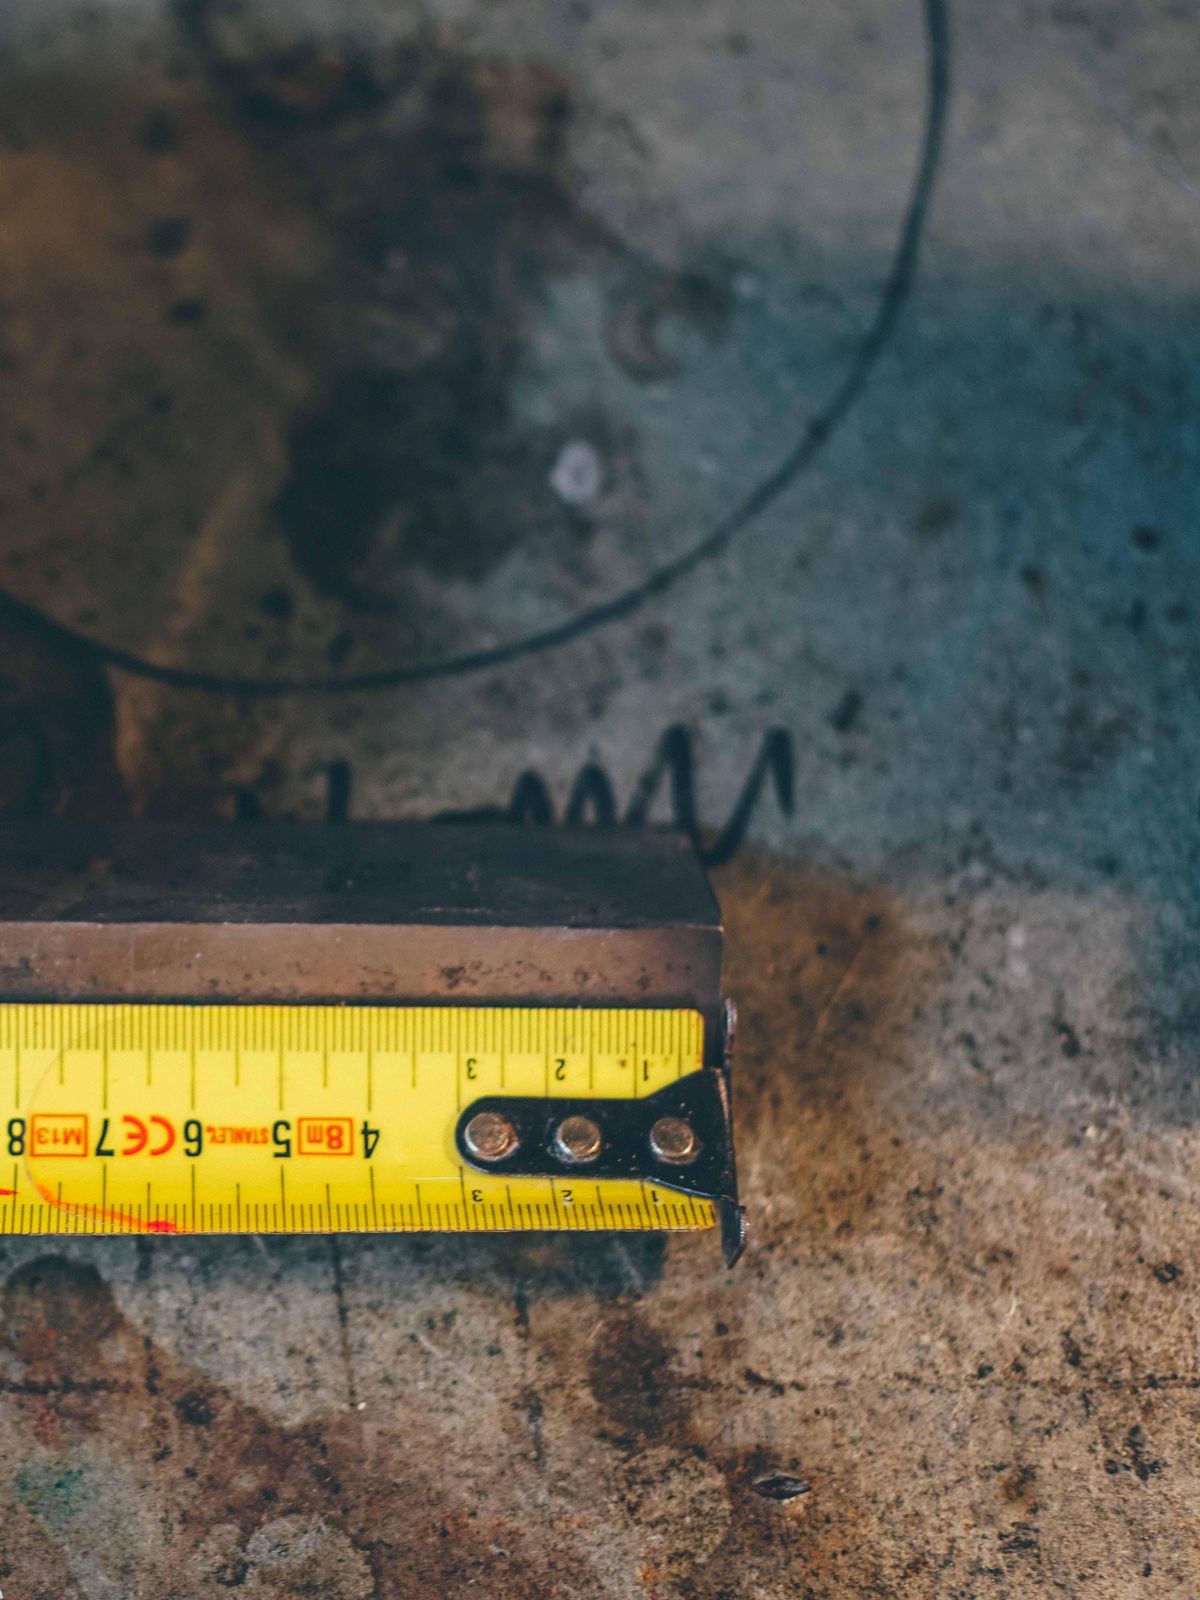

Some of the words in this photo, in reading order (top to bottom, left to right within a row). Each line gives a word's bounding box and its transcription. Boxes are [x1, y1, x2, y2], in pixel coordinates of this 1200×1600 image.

[467, 1058, 478, 1081] 3
[555, 1058, 566, 1081] 2
[642, 1059, 649, 1081] 1
[7, 1118, 27, 1157] 8
[35, 1126, 83, 1146] M13
[95, 1118, 116, 1157] 7
[184, 1119, 204, 1157] 6
[211, 1126, 270, 1145] STANLEY
[272, 1120, 292, 1158] 5
[306, 1124, 344, 1150] 8m
[361, 1120, 380, 1159] 4
[471, 1189, 484, 1203] 3
[560, 1189, 573, 1203] 2
